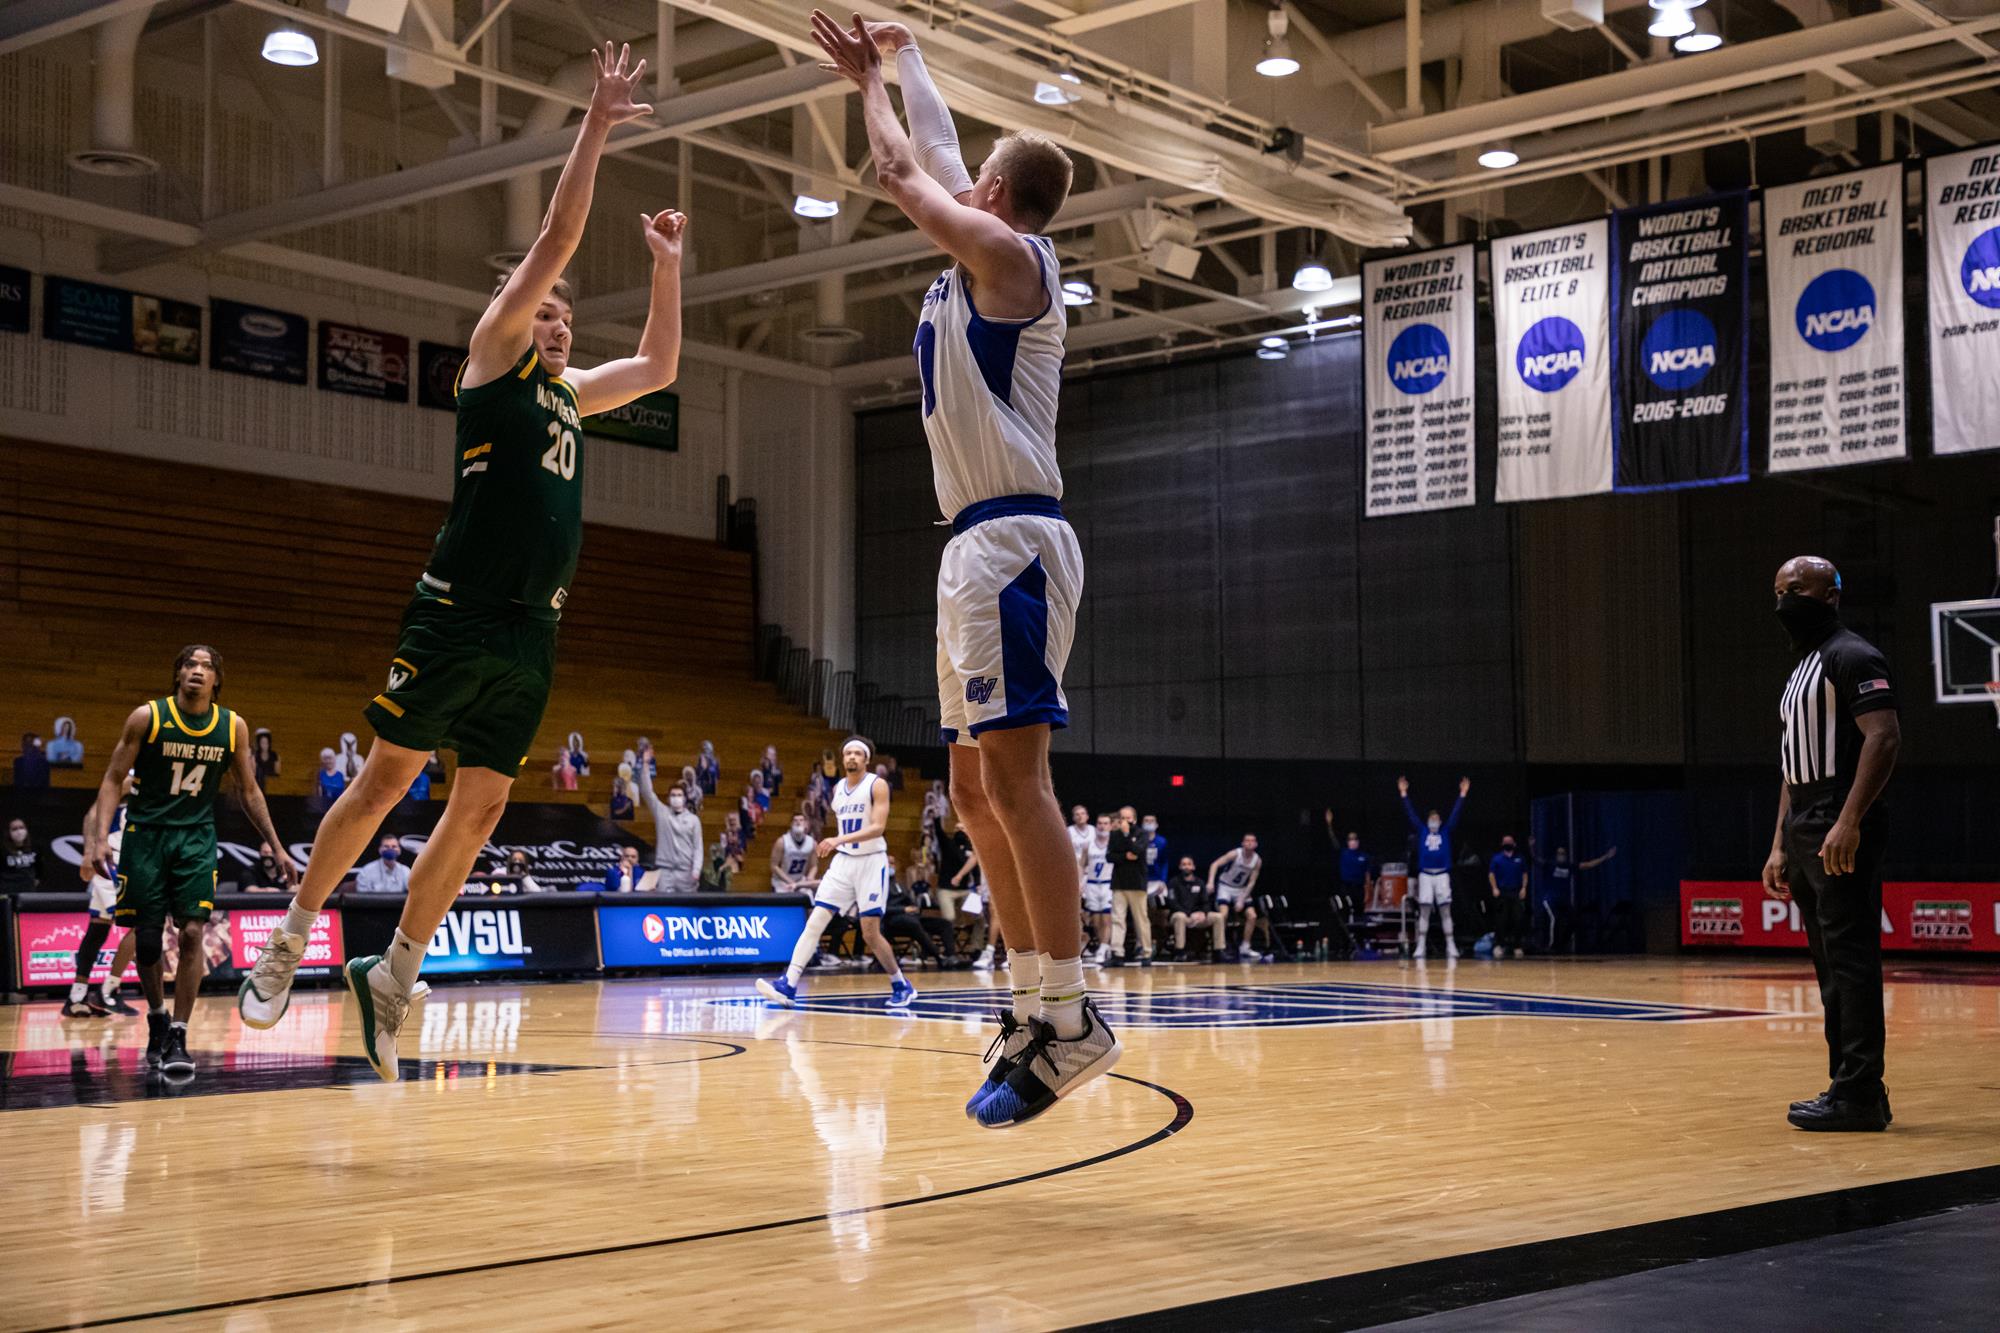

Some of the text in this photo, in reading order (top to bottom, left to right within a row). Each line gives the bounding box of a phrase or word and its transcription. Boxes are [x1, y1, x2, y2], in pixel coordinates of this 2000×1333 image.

[1802, 180, 1862, 209] MEN'S
[1638, 206, 1720, 237] WOMEN'S
[1779, 199, 1888, 236] BASKETBALL
[1511, 233, 1587, 261] WOMEN'S
[1629, 228, 1732, 262] BASKETBALL
[1792, 226, 1875, 257] REGIONAL
[1384, 256, 1455, 283] WOMEN'S
[1504, 253, 1594, 284] BASKETBALL
[1639, 253, 1718, 282] NATIONAL
[1373, 273, 1463, 304] BASKETBALL
[1521, 281, 1563, 303] ELITE
[1631, 275, 1727, 307] CHAMPIONS
[1382, 296, 1453, 322] REGIONAL
[1805, 305, 1874, 337] NCAA
[1394, 355, 1449, 380] NCAA
[1523, 349, 1582, 377] NCAA
[1650, 345, 1715, 374] NCAA
[1633, 394, 1728, 423] 2005-2006
[541, 420, 576, 481] 20
[162, 741, 225, 762] WAYNE STATE
[169, 761, 207, 798] 14
[429, 910, 525, 957] GVSU
[665, 916, 771, 940] PNC BANK
[1691, 920, 1742, 933] PIZZA
